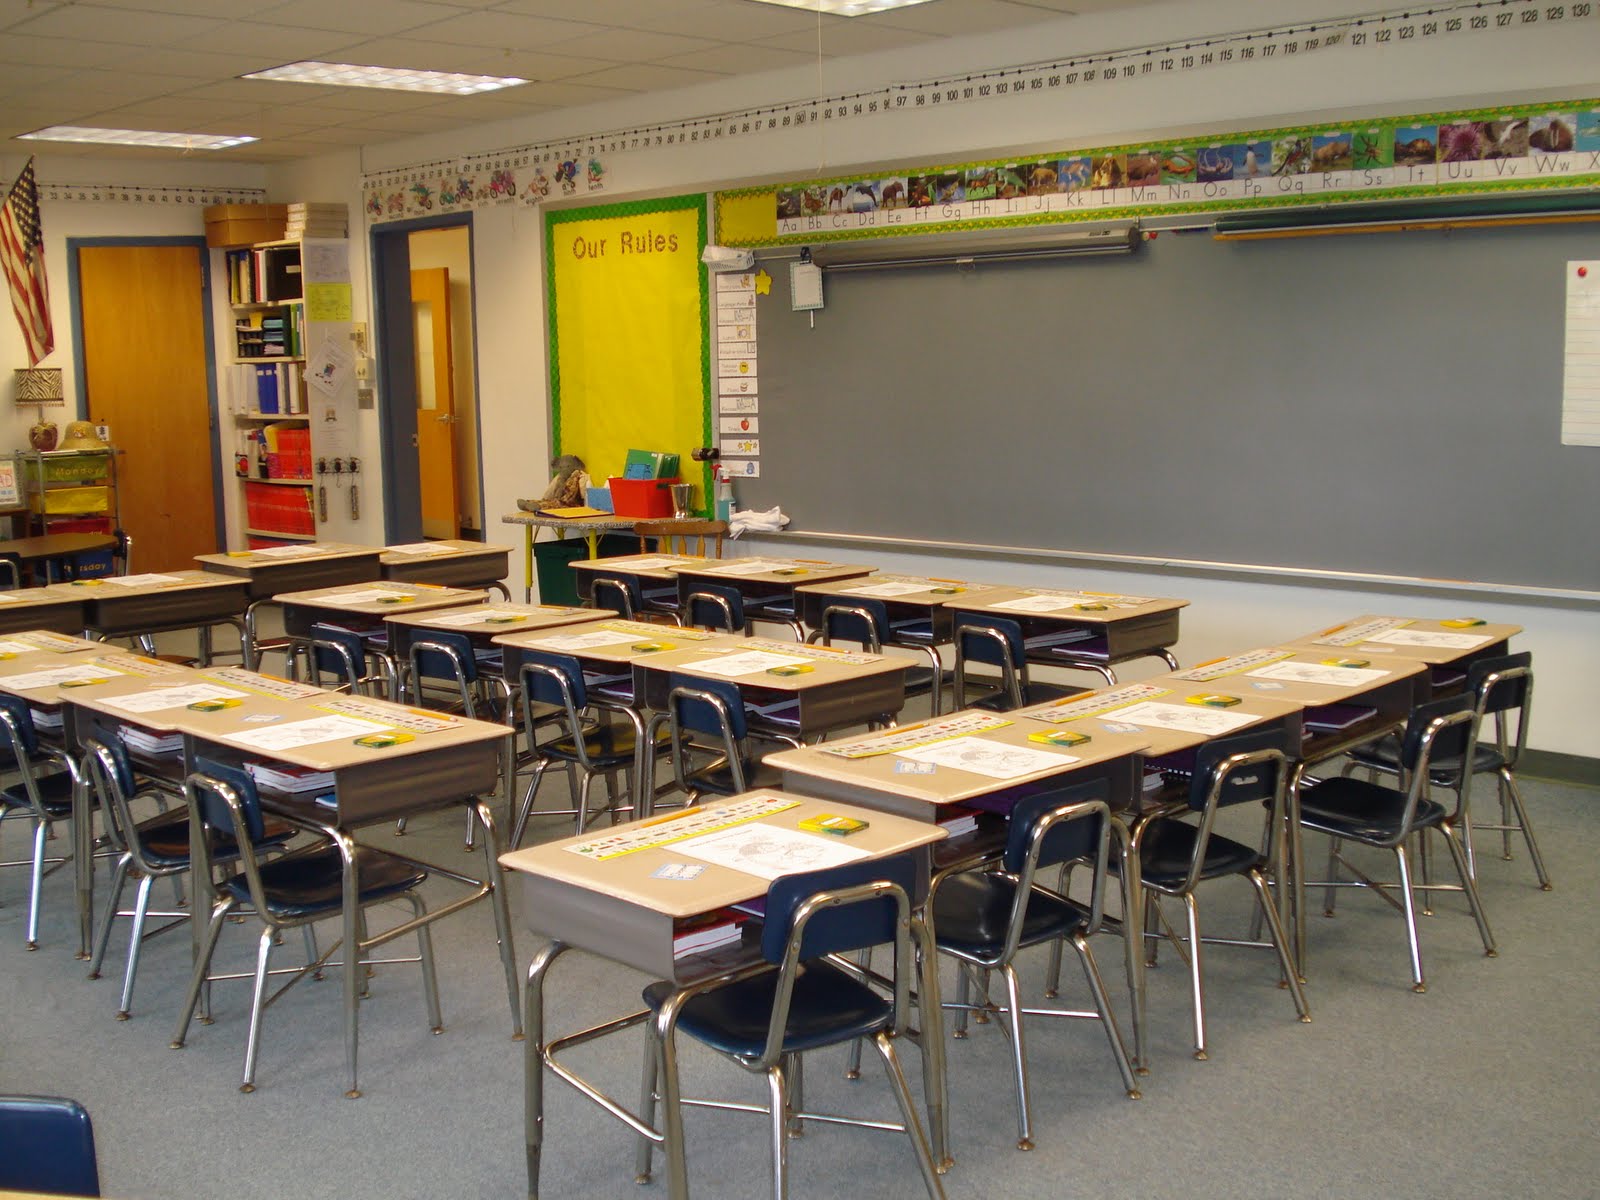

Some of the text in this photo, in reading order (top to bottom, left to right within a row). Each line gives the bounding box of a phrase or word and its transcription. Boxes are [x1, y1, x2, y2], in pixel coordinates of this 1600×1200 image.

[588, 146, 595, 155] 73
[782, 116, 790, 126] 89
[811, 111, 818, 122] 91
[824, 109, 832, 119] 92
[838, 106, 847, 117] 93
[854, 104, 862, 114] 94
[869, 102, 877, 112] 95
[897, 96, 907, 107] 97
[915, 95, 925, 105] 98
[932, 93, 941, 103] 99
[947, 91, 958, 101] 100
[963, 87, 973, 98] 101
[978, 86, 991, 96] 102
[996, 83, 1008, 94] 103
[1013, 81, 1025, 91] 104
[1031, 78, 1043, 89] 105
[1048, 75, 1060, 87] 106
[1066, 73, 1078, 84] 107
[1083, 70, 1095, 82] 108
[1103, 68, 1117, 80] 109
[1123, 65, 1135, 78] 110
[1142, 61, 1153, 73] 111
[1160, 58, 1174, 70] 112
[1181, 56, 1194, 68] 113
[1200, 53, 1213, 65] 114
[1220, 50, 1233, 61] 115
[1240, 47, 1254, 58] 116
[1262, 44, 1276, 56] 117
[1284, 42, 1298, 54] 118
[1352, 33, 1367, 45] 121
[1375, 30, 1391, 43] 122
[1398, 26, 1415, 39] 123
[1422, 22, 1437, 35] 124
[1446, 18, 1462, 32] 125
[1470, 15, 1488, 29] 126
[1496, 13, 1513, 26] 127
[1521, 9, 1538, 24] 128
[1547, 6, 1564, 20] 129
[1572, 3, 1590, 17] 130
[50, 192, 58, 200] 33
[64, 192, 72, 200] 34
[782, 218, 797, 232] Aa
[808, 216, 822, 230] Bb
[832, 213, 847, 228] Cc
[858, 211, 875, 226] Dd
[887, 209, 902, 224] Ee
[915, 207, 929, 221] Ff
[942, 203, 961, 222] Gg
[971, 200, 990, 215] Hh
[1006, 198, 1018, 213] Ii
[1035, 195, 1050, 214] Jj
[1066, 192, 1084, 207] Kk
[1102, 188, 1116, 204] Ll
[1131, 186, 1157, 202] Mm
[1169, 184, 1190, 199] Nn
[1203, 181, 1227, 197] Oo
[1244, 178, 1262, 198] Pp
[1278, 175, 1303, 195] Qq
[1323, 172, 1341, 189] Rr
[1364, 169, 1382, 186] Ss
[1407, 165, 1424, 182] Tt
[1448, 162, 1473, 179] Uu
[1494, 158, 1517, 176] Vv
[1535, 155, 1570, 173] Ww
[573, 229, 678, 260] Our Rules
[55, 467, 100, 476] Monday
